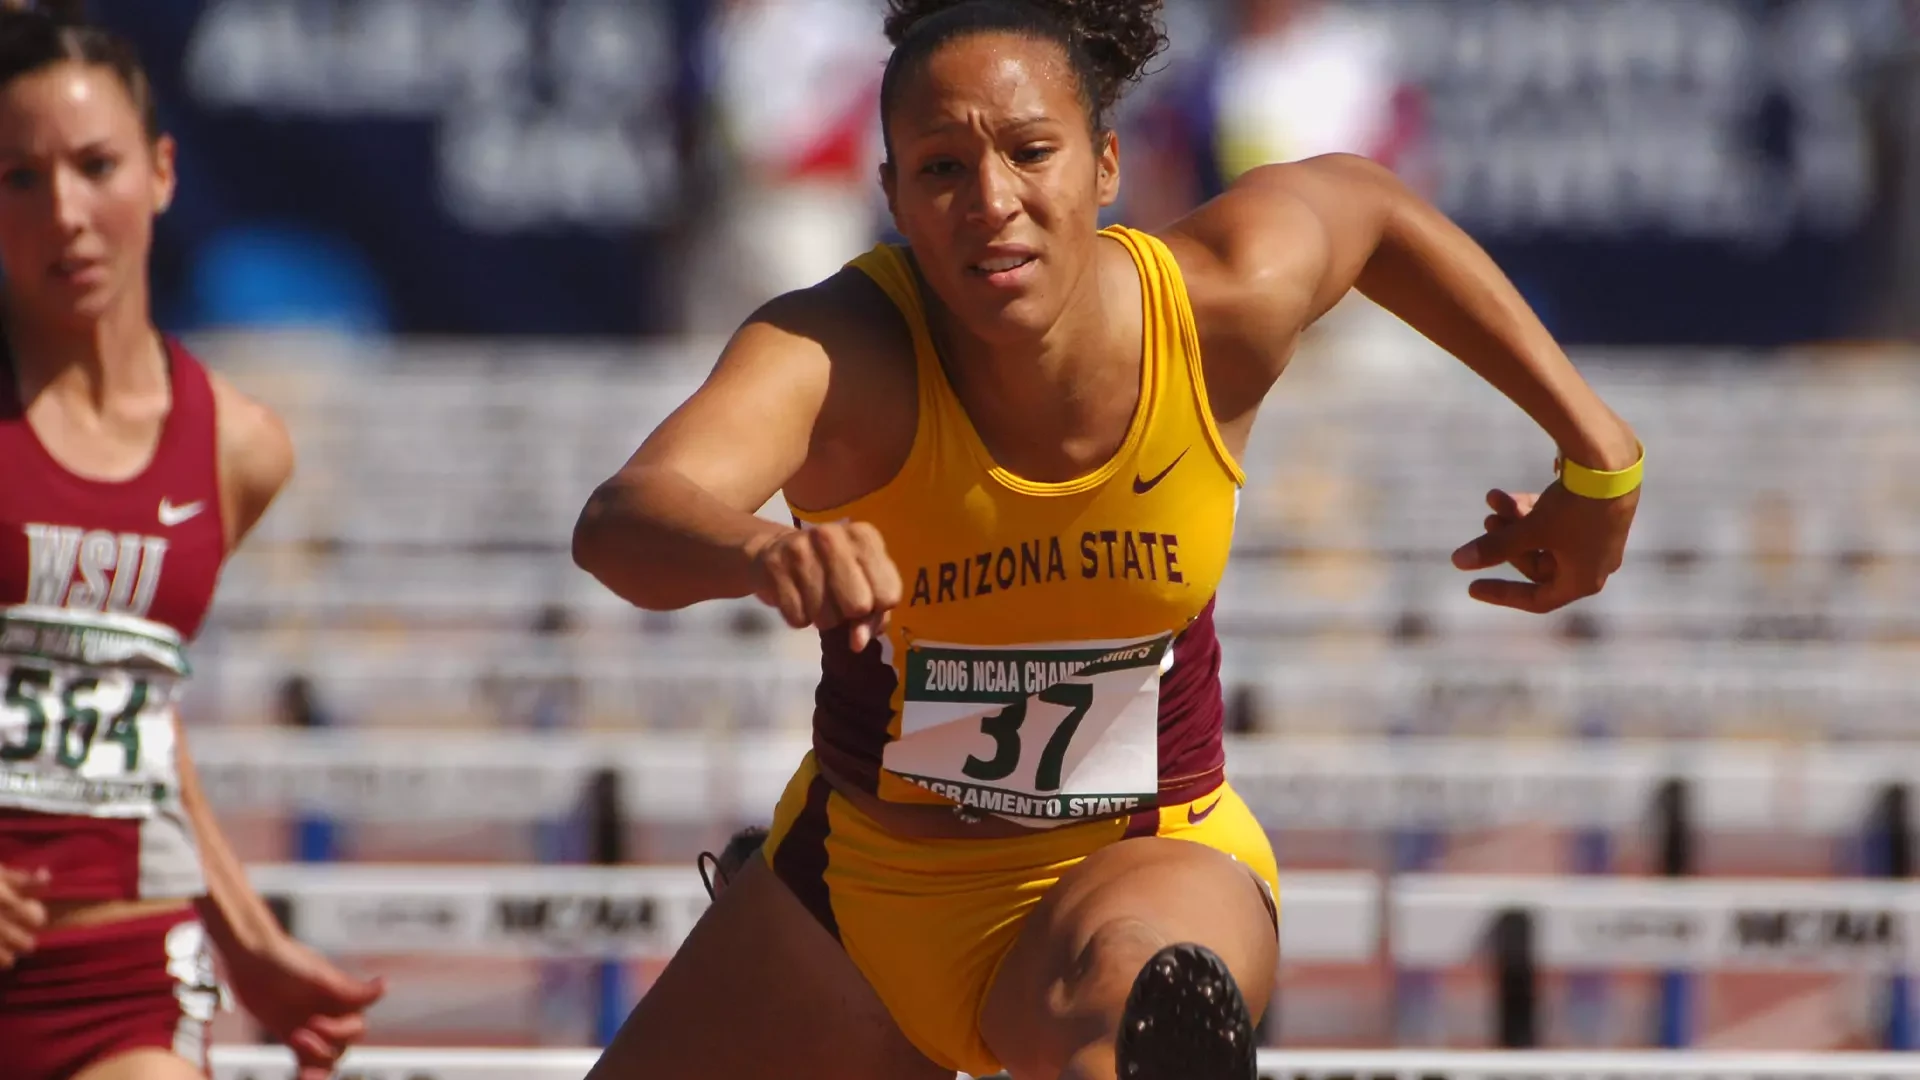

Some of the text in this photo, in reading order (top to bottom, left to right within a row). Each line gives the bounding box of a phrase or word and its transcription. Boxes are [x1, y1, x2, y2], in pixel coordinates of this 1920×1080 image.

[24, 522, 168, 618] WSU
[910, 530, 1185, 607] ARIZONA STATE
[0, 666, 149, 770] 564
[925, 659, 968, 692] 2006
[973, 660, 1020, 693] NCAA
[962, 683, 1094, 792] 37
[902, 776, 1140, 818] ACRAMENTO STATE
